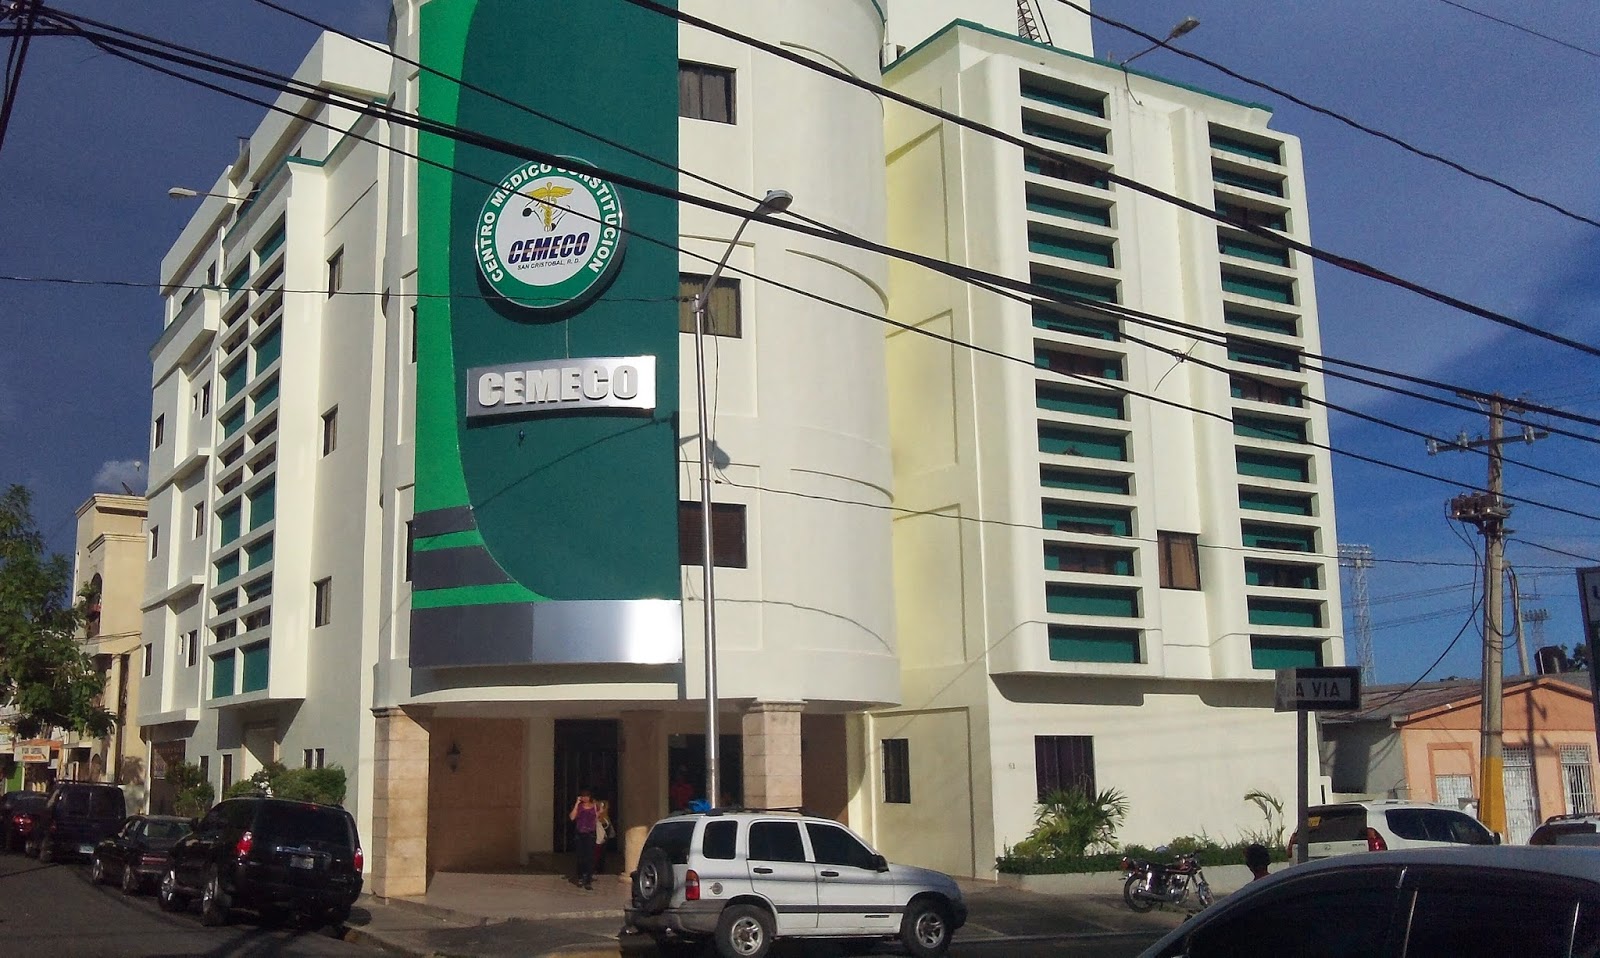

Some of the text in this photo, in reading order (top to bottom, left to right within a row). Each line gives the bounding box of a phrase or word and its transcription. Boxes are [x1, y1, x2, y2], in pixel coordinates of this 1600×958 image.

[481, 212, 503, 282] CENTRO
[556, 166, 617, 273] STITUCION
[508, 232, 589, 264] CEMECO
[478, 365, 638, 407] CEMECO
[1312, 681, 1340, 698] VIA
